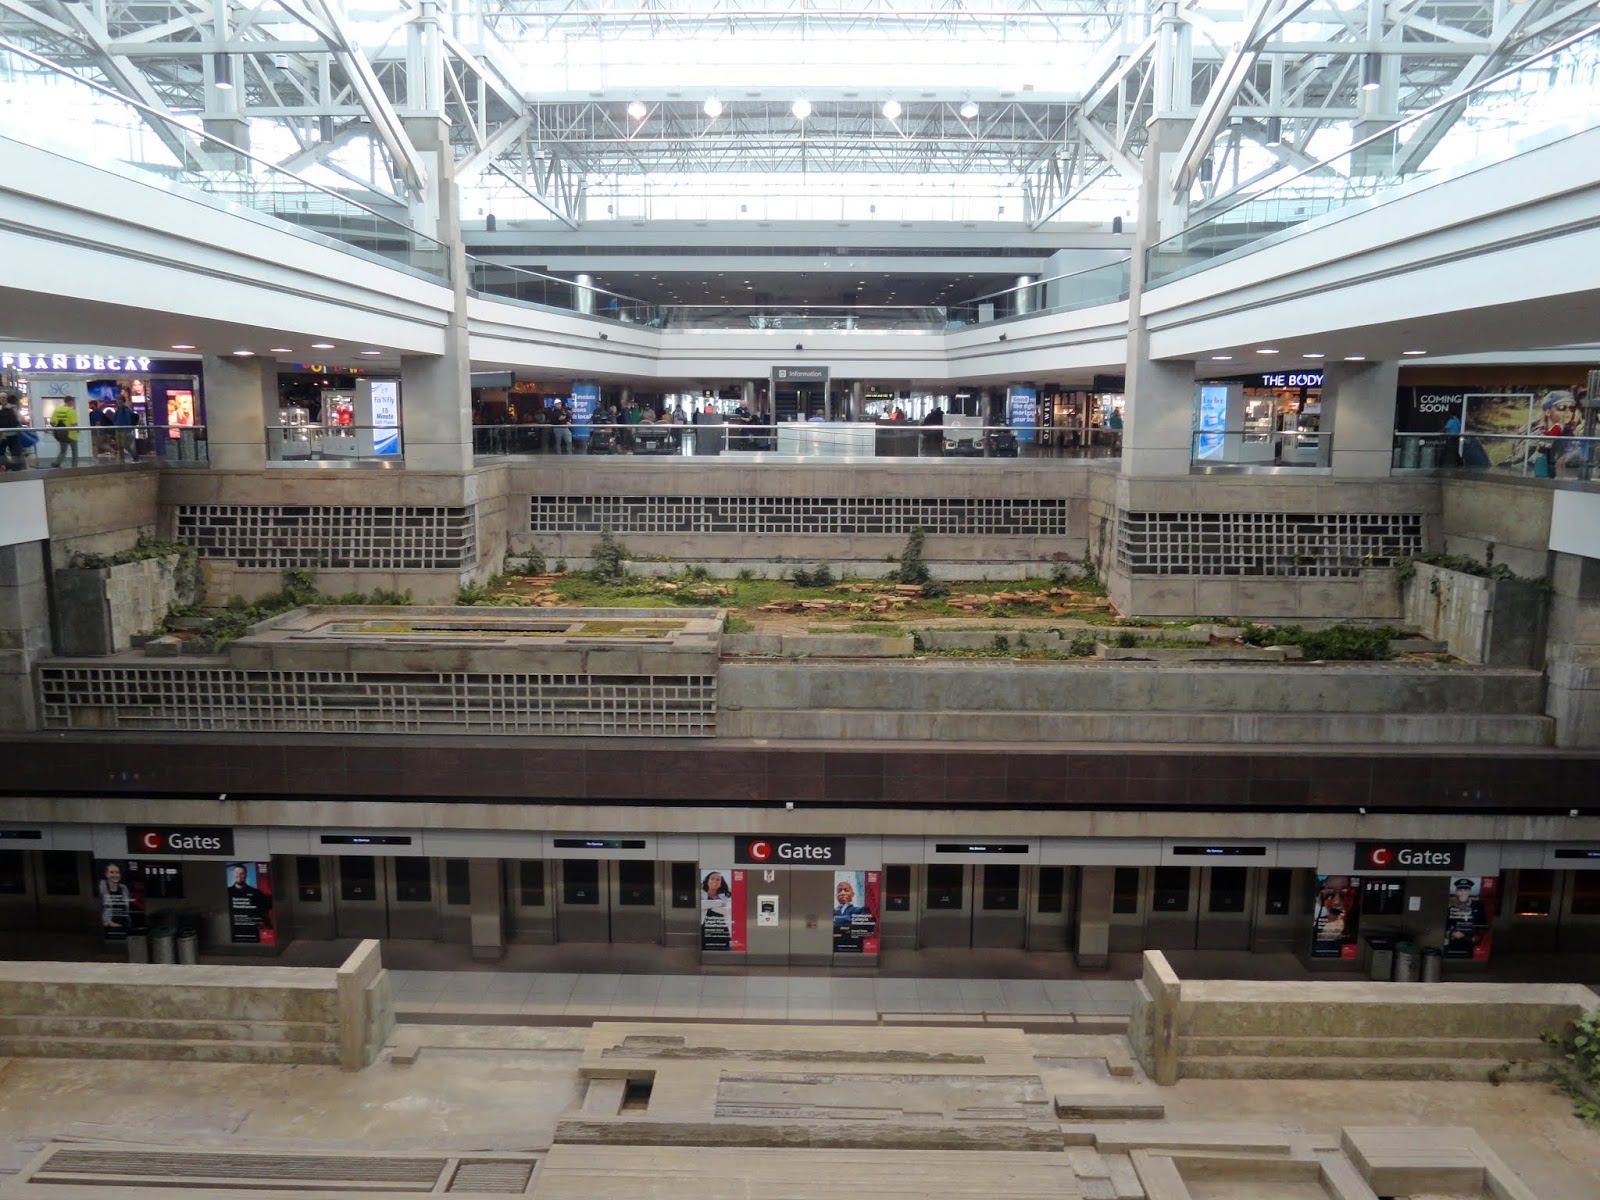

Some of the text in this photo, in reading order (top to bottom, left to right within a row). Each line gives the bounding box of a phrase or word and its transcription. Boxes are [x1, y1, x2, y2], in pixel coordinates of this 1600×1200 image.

[75, 357, 150, 370] DECAY
[1262, 374, 1324, 386] THE BODY
[1420, 395, 1462, 403] COMING
[1420, 404, 1449, 412] SOON
[144, 833, 221, 849] C Gates
[752, 842, 832, 859] C Gates
[1373, 848, 1451, 865] C Gates
